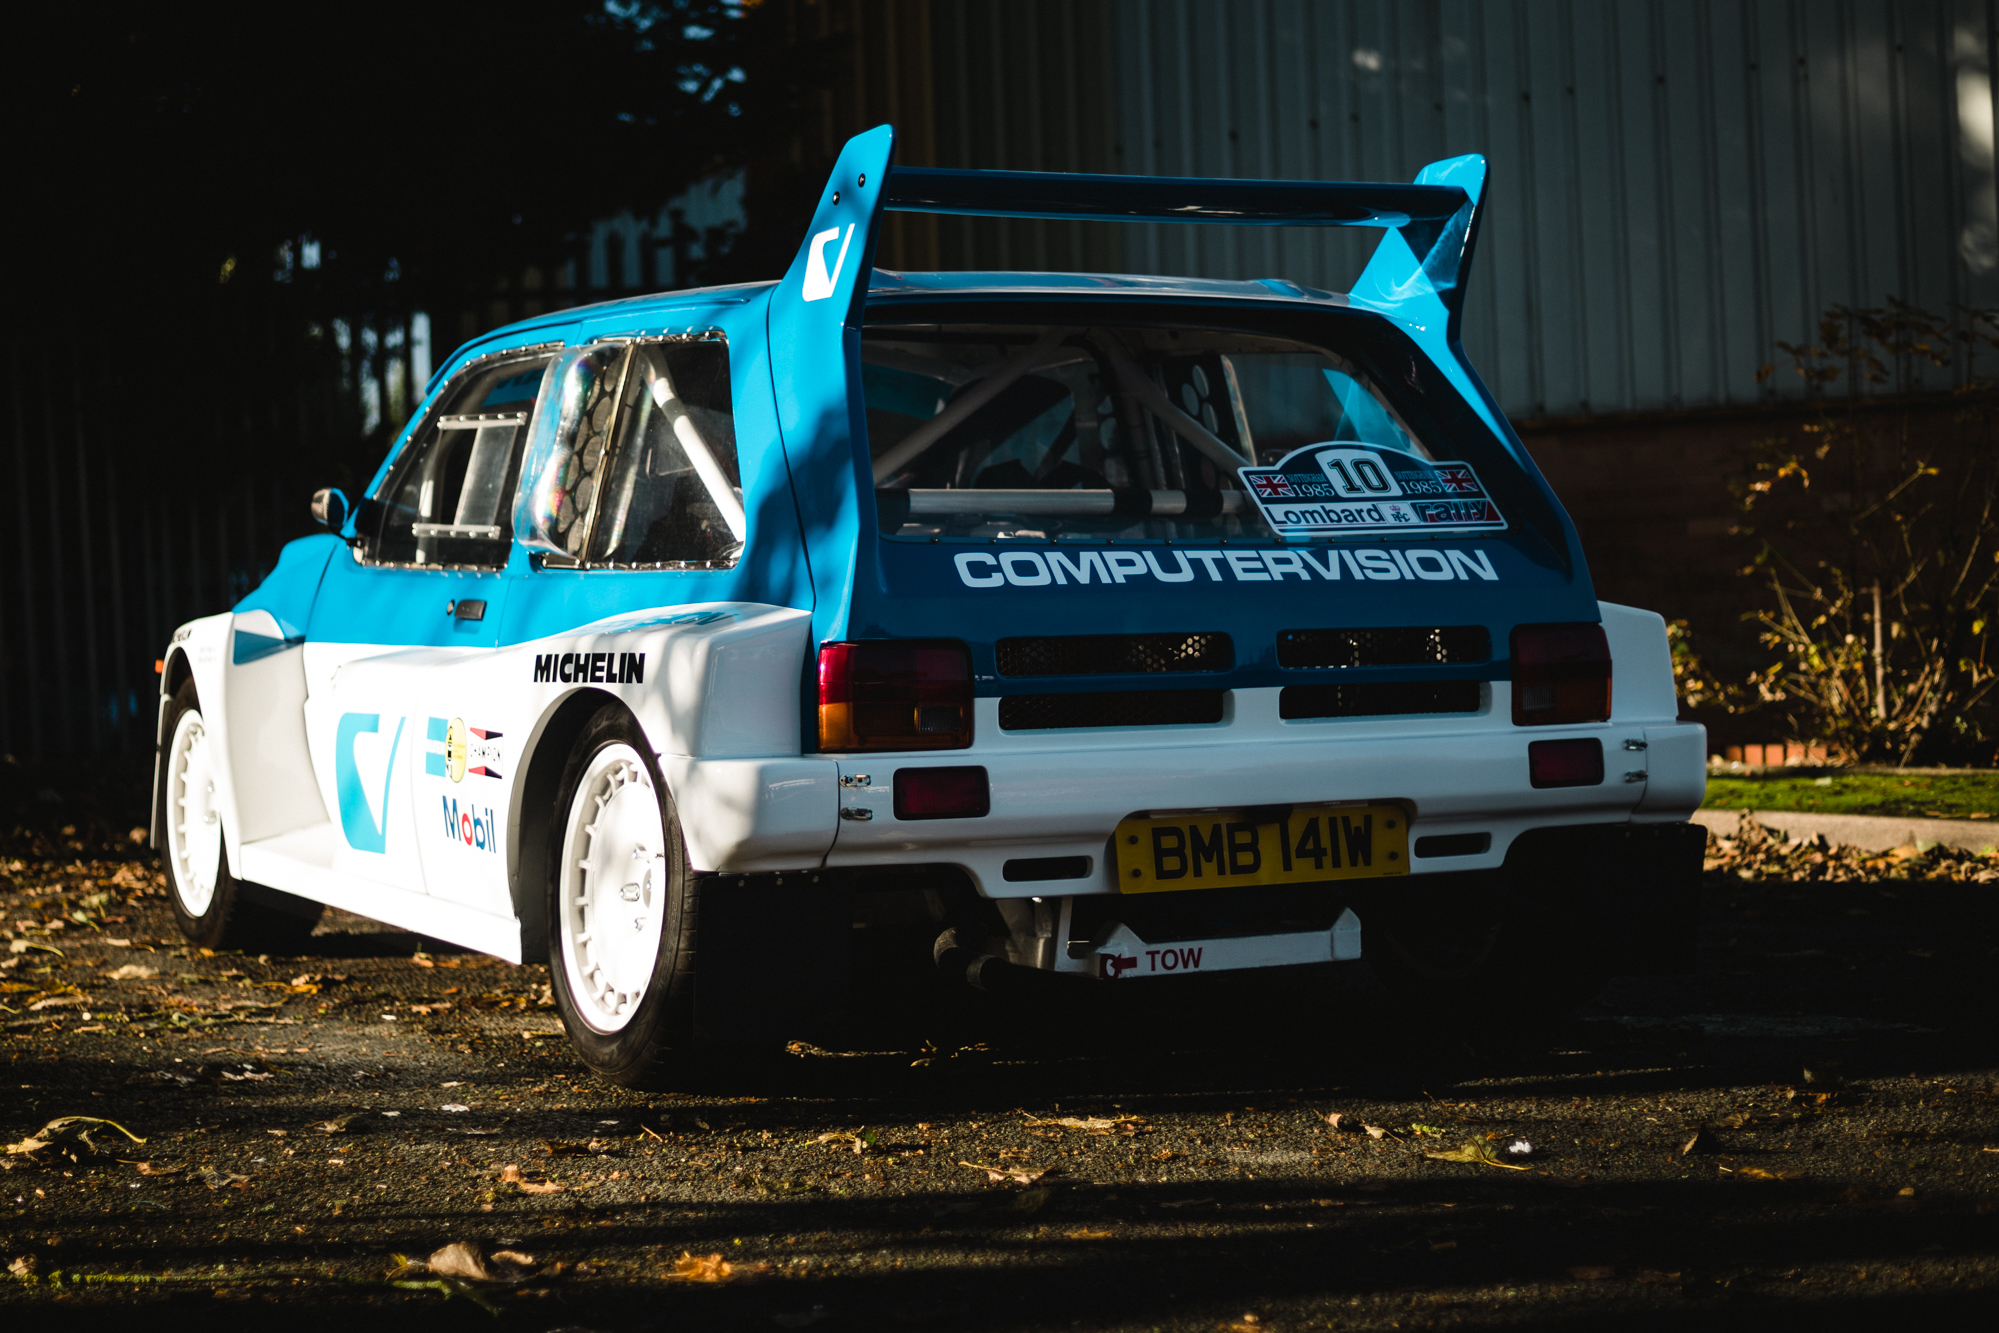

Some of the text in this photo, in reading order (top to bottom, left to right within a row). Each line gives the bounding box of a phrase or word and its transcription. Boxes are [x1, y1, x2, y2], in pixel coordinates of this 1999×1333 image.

[1286, 473, 1326, 484] NOTTINGHAM
[1326, 458, 1392, 493] 10
[1401, 479, 1443, 495] 1985
[1293, 482, 1336, 498] 1985
[1264, 504, 1386, 525] Lombard
[953, 549, 1500, 588] COMPUTERVISION
[533, 652, 646, 684] MICHELIN
[441, 794, 497, 854] Mobil
[1150, 821, 1262, 881] BMB
[1145, 947, 1203, 972] TOW
